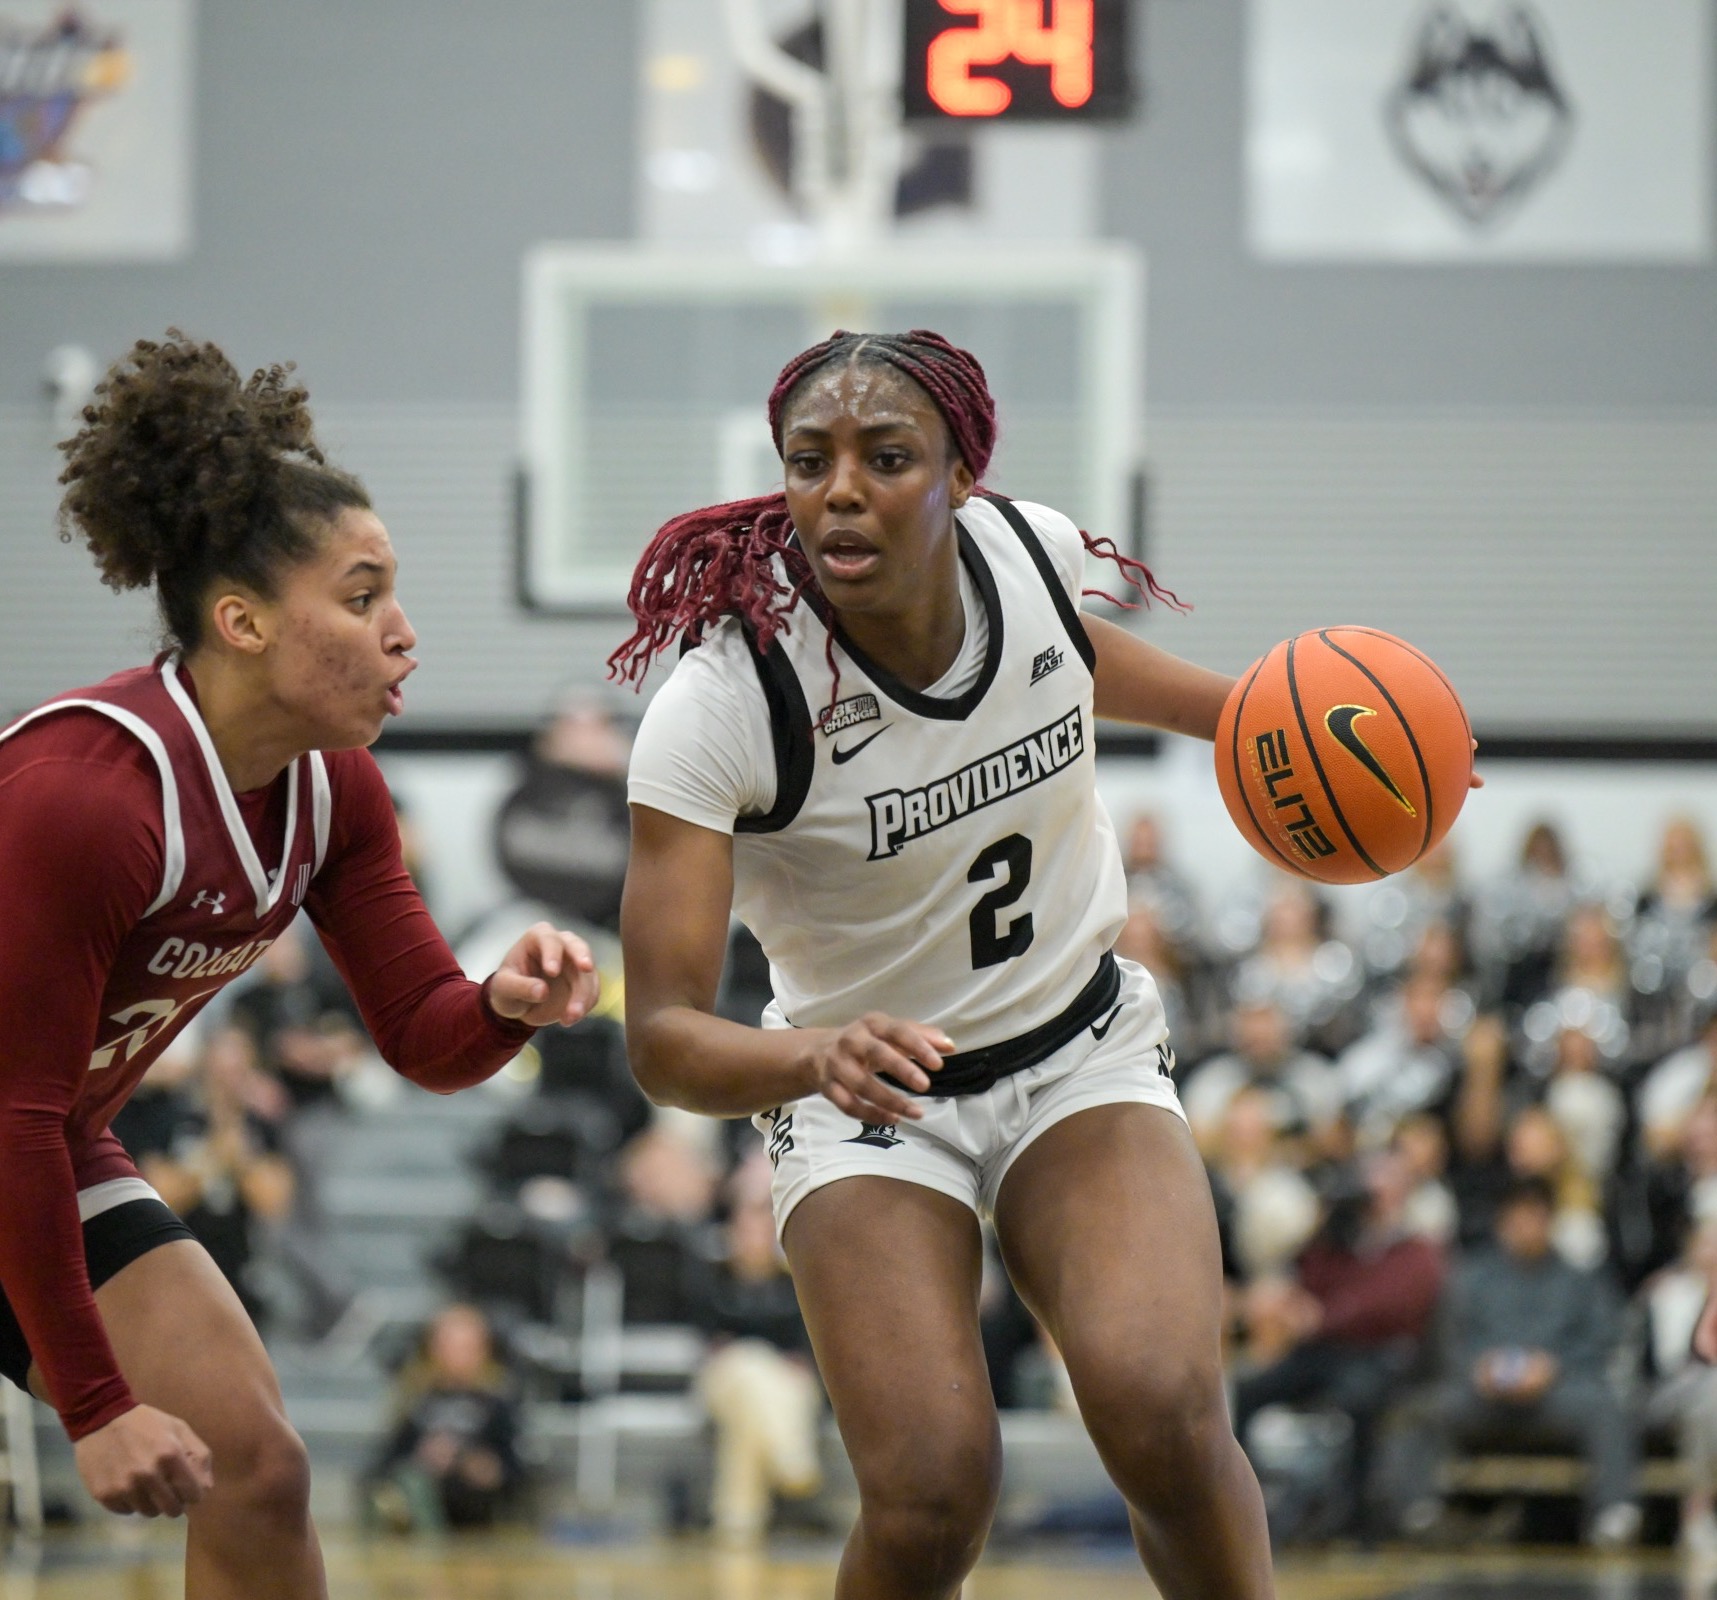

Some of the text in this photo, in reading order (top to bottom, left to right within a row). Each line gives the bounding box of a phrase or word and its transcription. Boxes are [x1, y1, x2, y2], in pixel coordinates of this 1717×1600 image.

[927, 0, 1093, 116] 24
[1031, 651, 1064, 680] EAST
[1033, 645, 1055, 669] BIG
[824, 707, 878, 734] CHANGE
[832, 700, 858, 720] BE
[856, 696, 876, 711] THE
[864, 705, 1084, 862] PROVIDENCE
[1255, 729, 1337, 860] ELITE
[967, 833, 1034, 971] 2
[147, 937, 275, 979] COLGAT
